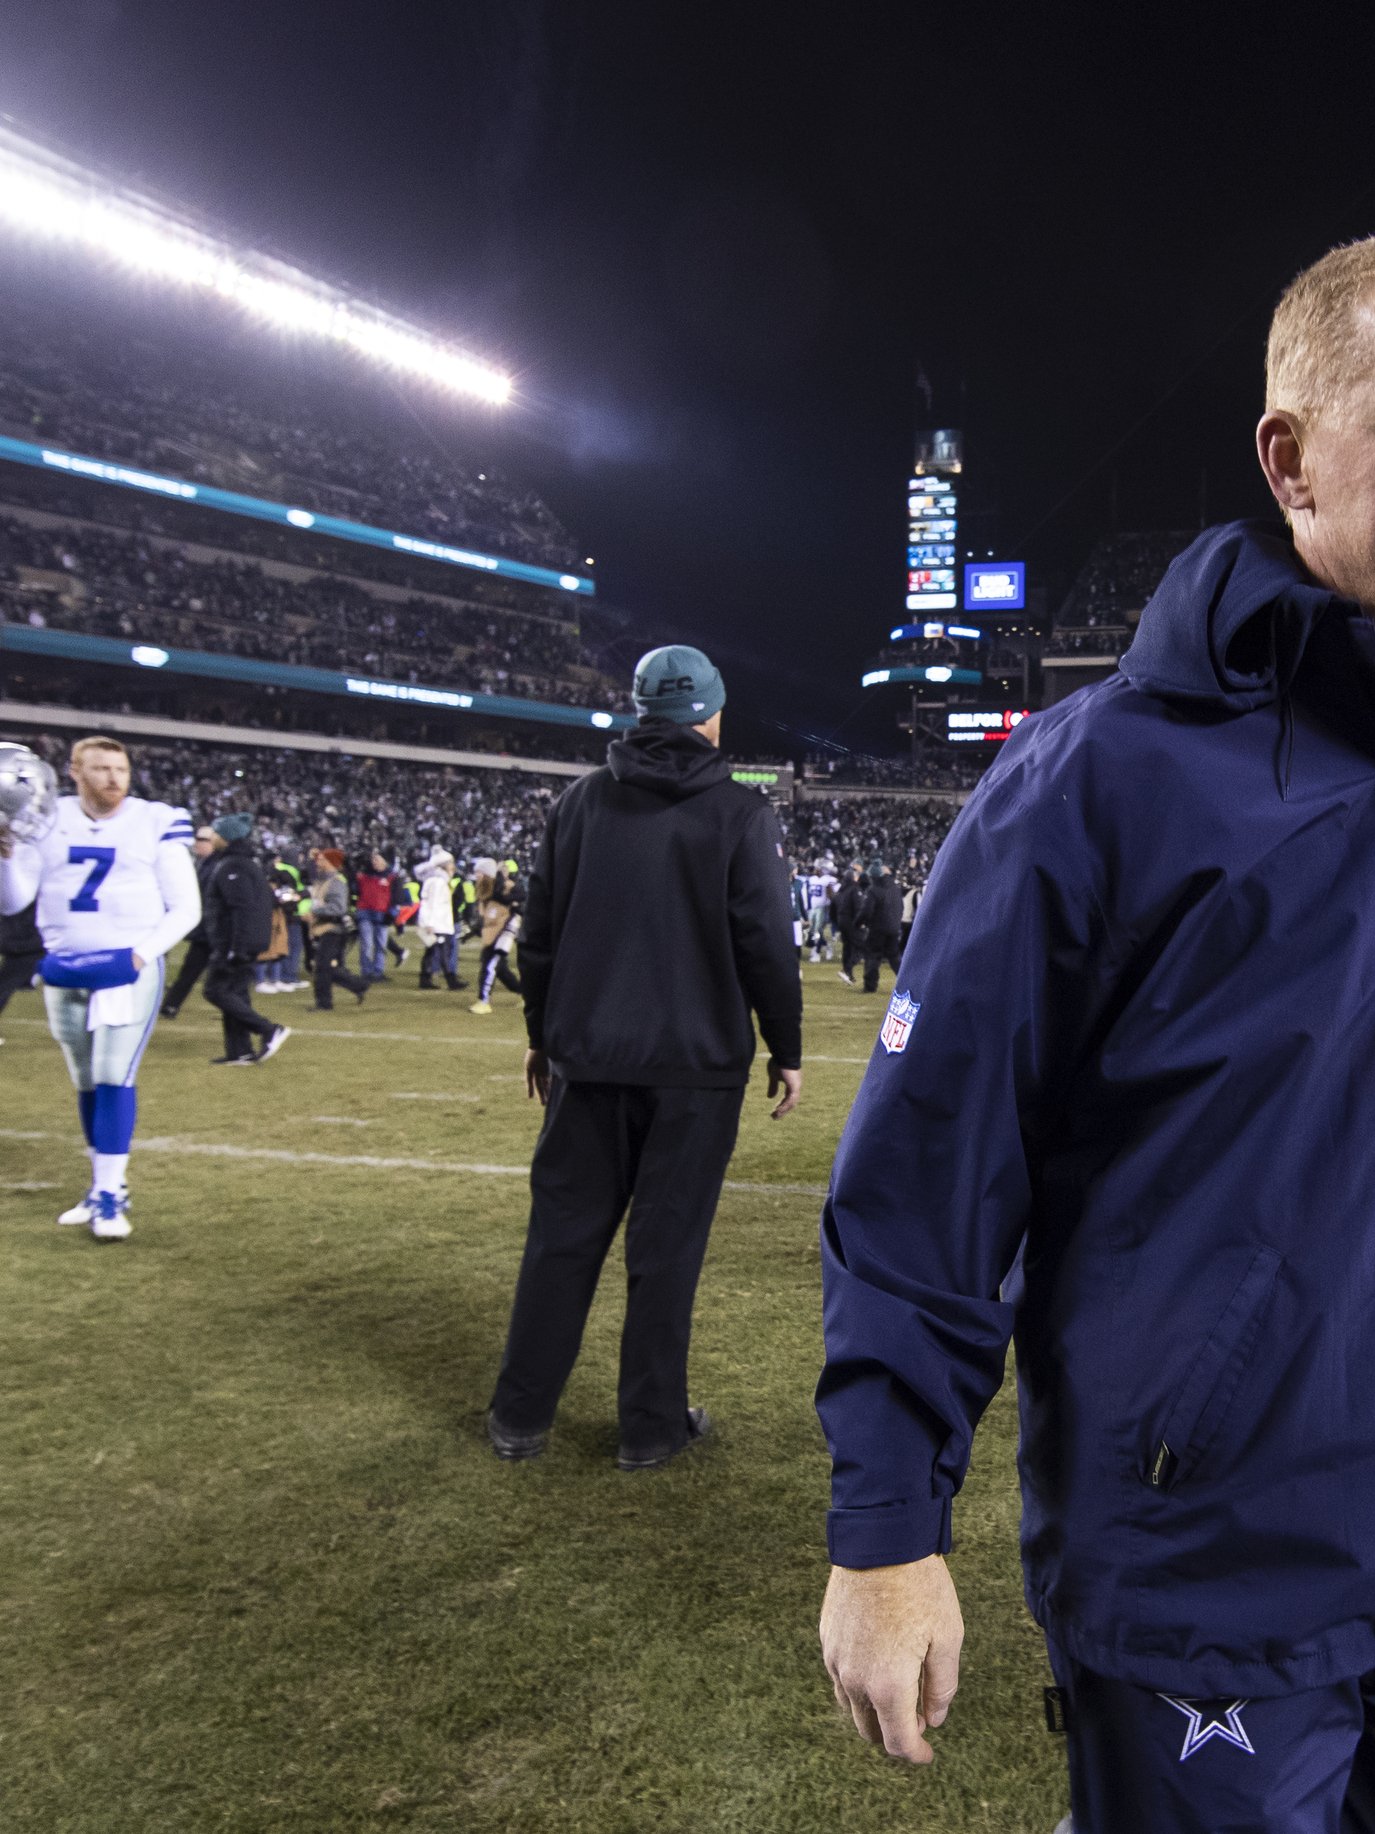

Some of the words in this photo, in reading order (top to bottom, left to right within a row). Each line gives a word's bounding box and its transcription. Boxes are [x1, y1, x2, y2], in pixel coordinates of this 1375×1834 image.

[948, 712, 1003, 728] BELFOR
[68, 846, 116, 912] 7
[882, 1014, 908, 1049] NFL
